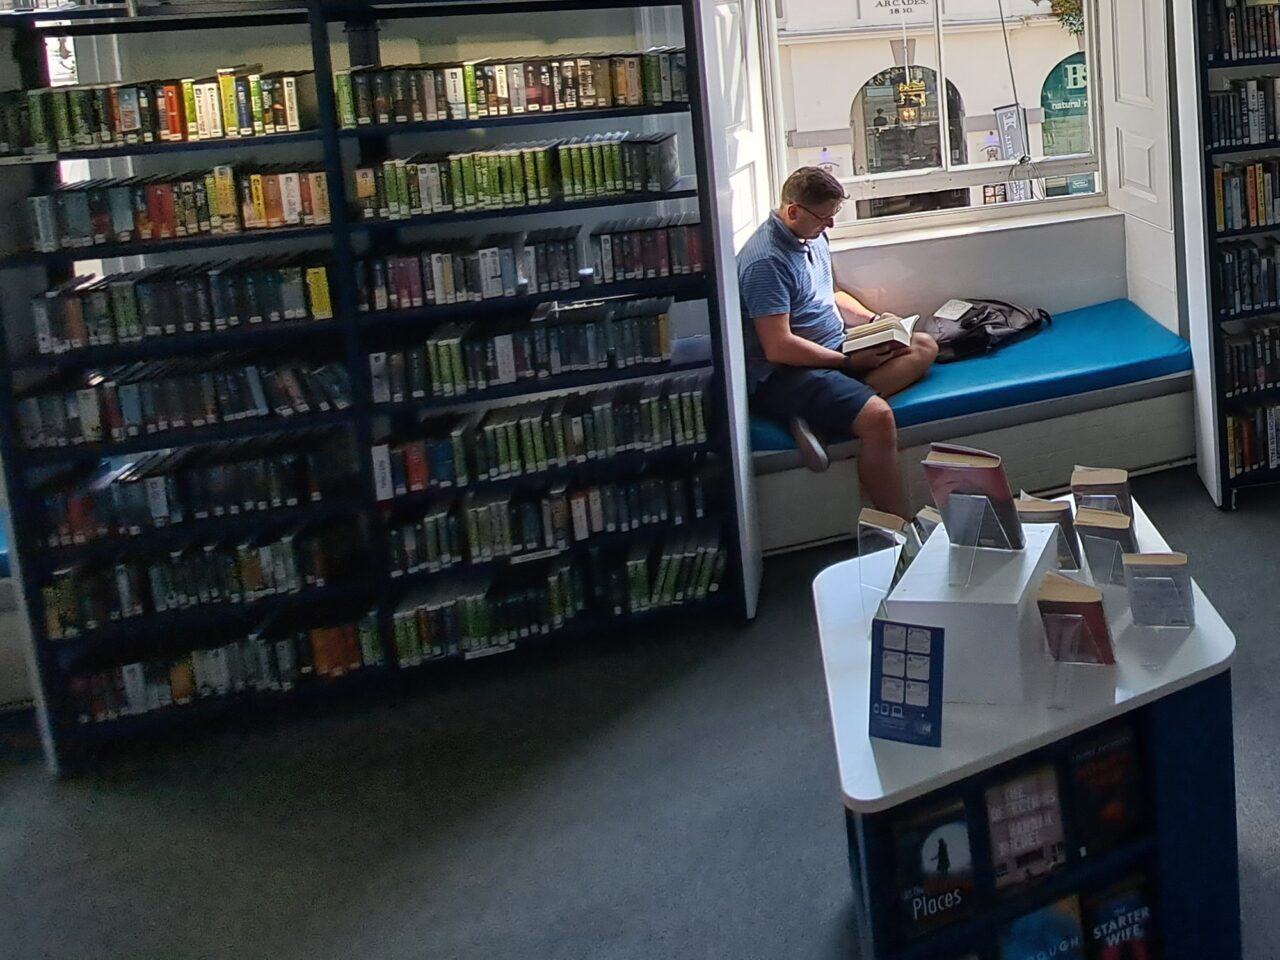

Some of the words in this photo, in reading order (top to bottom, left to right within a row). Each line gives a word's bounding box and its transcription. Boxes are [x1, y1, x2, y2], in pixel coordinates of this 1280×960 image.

[1052, 98, 1081, 110] natural
[912, 888, 962, 921] Places
[1093, 906, 1150, 940] STARTER
[1106, 924, 1142, 947] WIFE
[1028, 935, 1079, 960] OUGH
